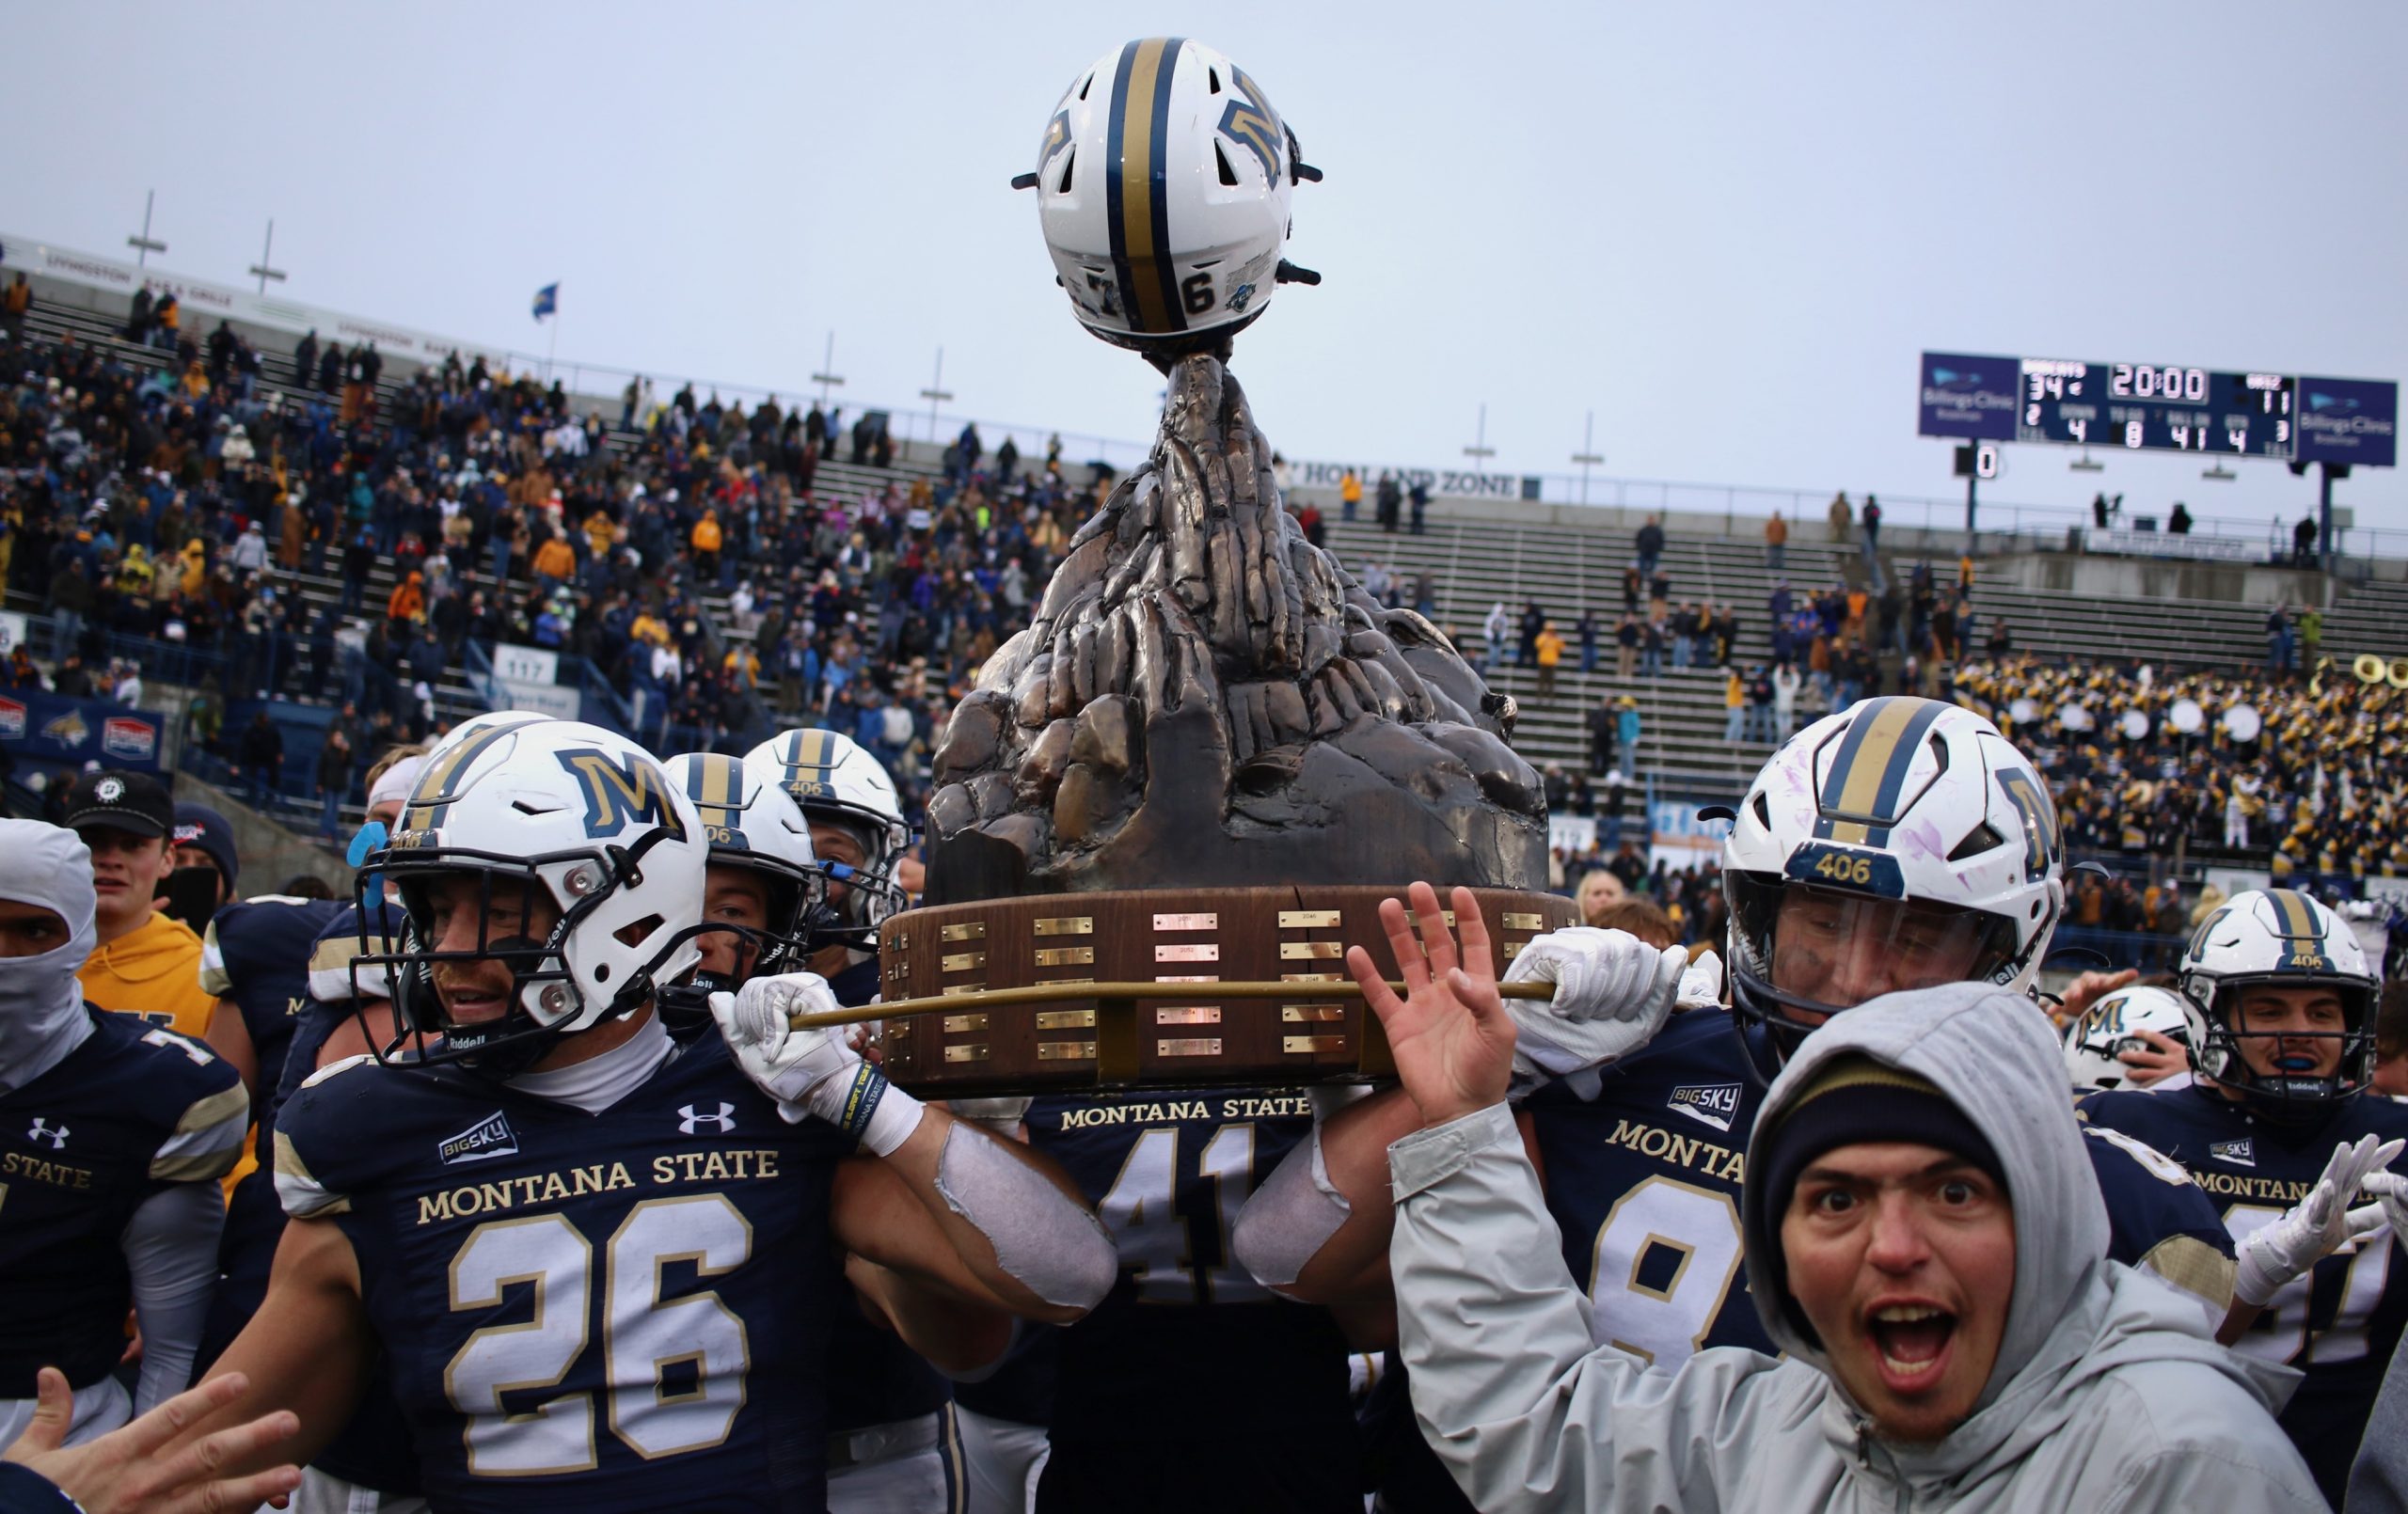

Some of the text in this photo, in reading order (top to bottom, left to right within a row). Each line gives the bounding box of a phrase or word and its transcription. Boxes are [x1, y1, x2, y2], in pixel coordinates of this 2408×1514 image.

[1181, 273, 1215, 314] 6
[2030, 373, 2063, 401] 34
[2113, 364, 2205, 401] 20:00
[2068, 418, 2086, 444] 4
[2125, 420, 2144, 449] 8
[2171, 425, 2207, 451] 41
[2228, 429, 2246, 454] 4
[1976, 446, 1997, 479] 0
[1441, 471, 1515, 496] ZONE
[508, 660, 543, 679] 117
[553, 748, 688, 844] M
[788, 781, 823, 796] 406
[705, 826, 731, 844] 06
[1814, 852, 1871, 885] 406
[2290, 954, 2323, 970] 406
[2076, 997, 2130, 1054] M
[1061, 1097, 1312, 1131] MONTANA STATE
[1605, 1119, 1745, 1184] MONTA
[2, 1152, 92, 1189] STATE
[2194, 1171, 2318, 1202] MONTAN
[416, 1150, 780, 1225] MONTANA STATE
[1096, 1122, 1277, 1305] 41
[1586, 1174, 1748, 1378] 8
[443, 1192, 752, 1476] 26
